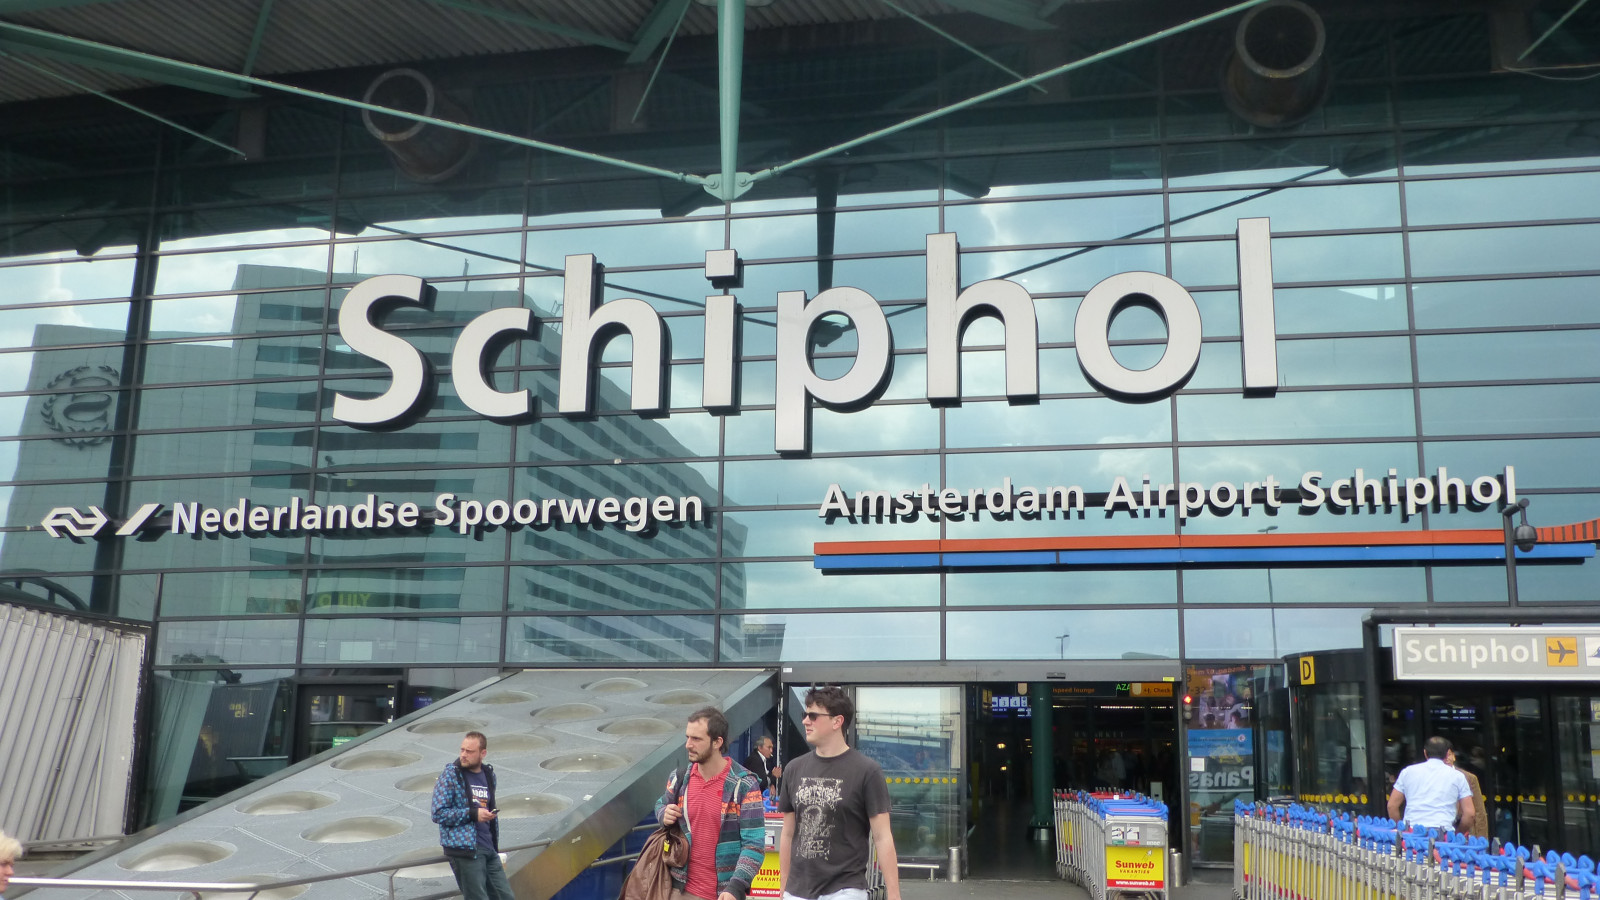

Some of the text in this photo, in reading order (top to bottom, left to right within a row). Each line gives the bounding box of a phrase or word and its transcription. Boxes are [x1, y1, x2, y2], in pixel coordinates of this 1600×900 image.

[332, 217, 1279, 455] Schiphol
[818, 465, 1517, 519] Amsterdam Airport Schiphol
[171, 492, 702, 534] Nederlandse Spoorwegen
[1302, 660, 1311, 680] D
[1405, 637, 1539, 669] Schiphol
[1115, 860, 1155, 869] Sunweb
